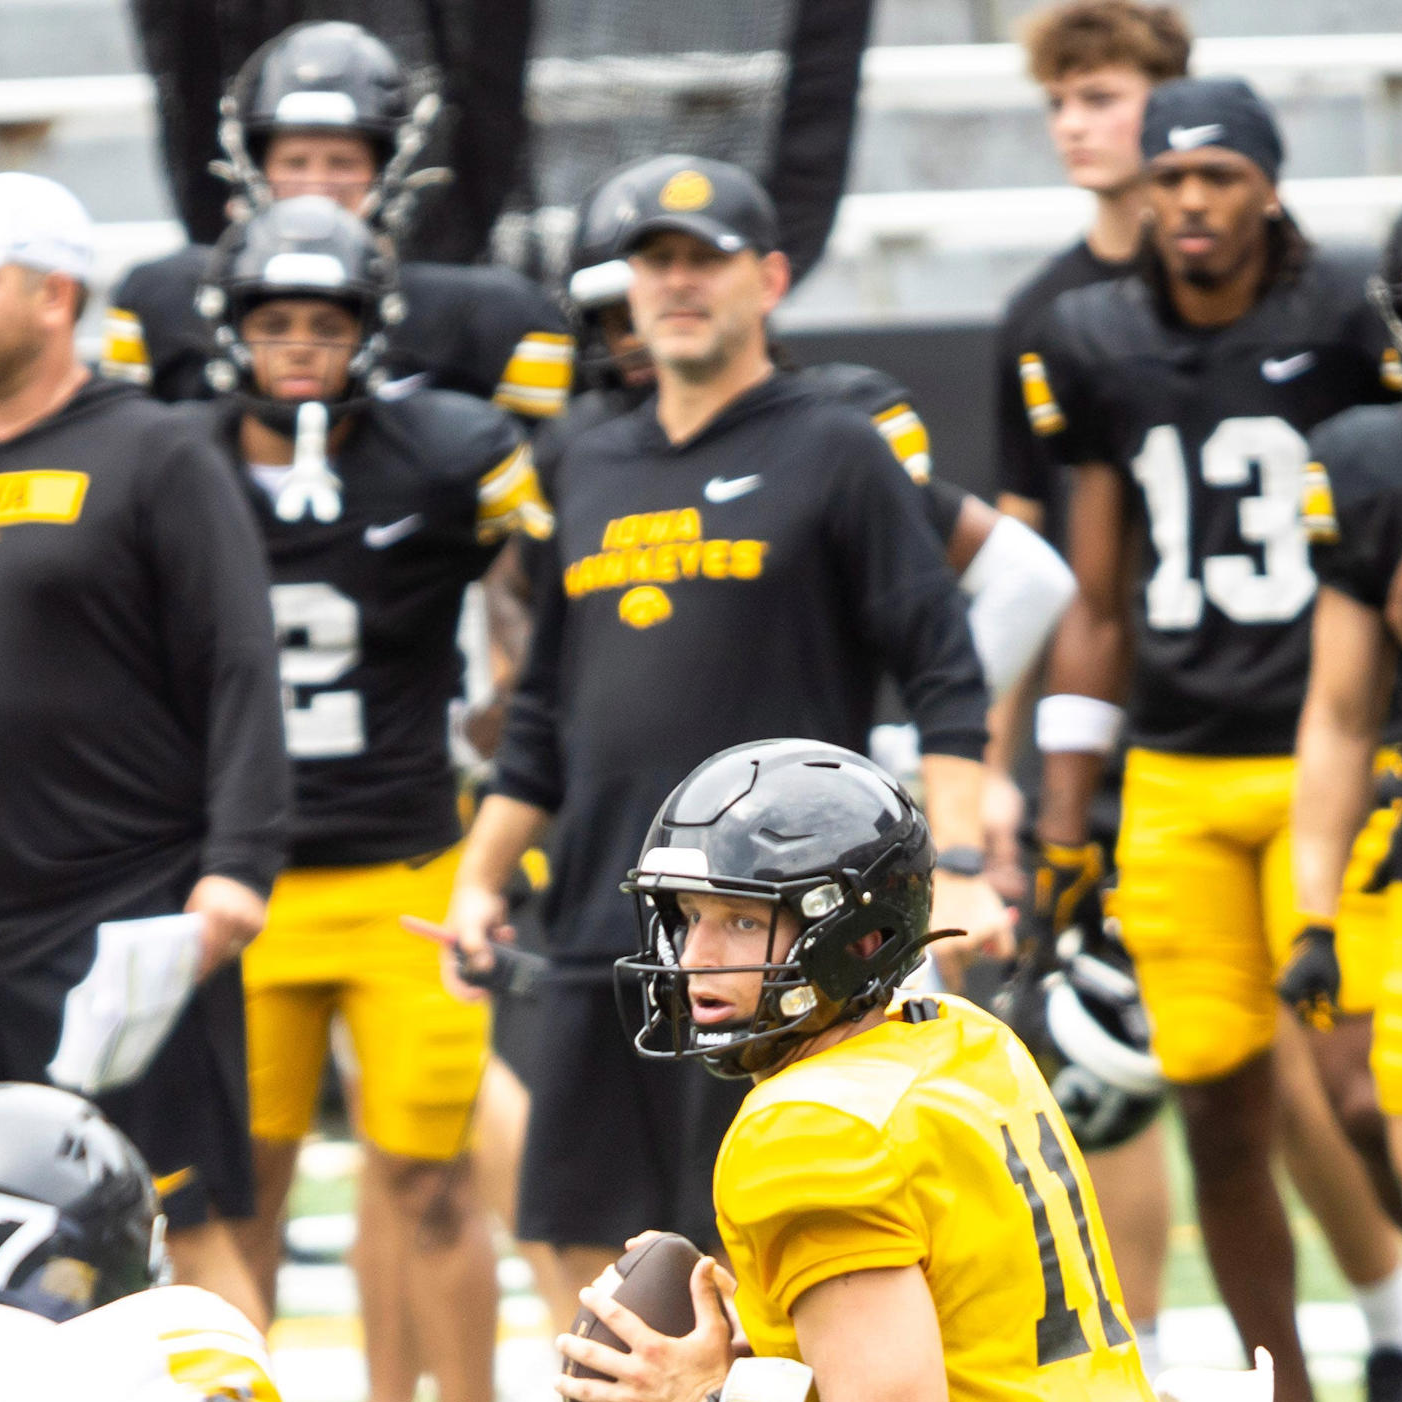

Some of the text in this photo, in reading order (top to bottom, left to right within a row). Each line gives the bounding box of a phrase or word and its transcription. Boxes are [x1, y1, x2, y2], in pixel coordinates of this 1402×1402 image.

[602, 507, 701, 550] IOWA
[1131, 416, 1319, 632] 13
[270, 583, 366, 760] 2
[1000, 1111, 1134, 1367] 11
